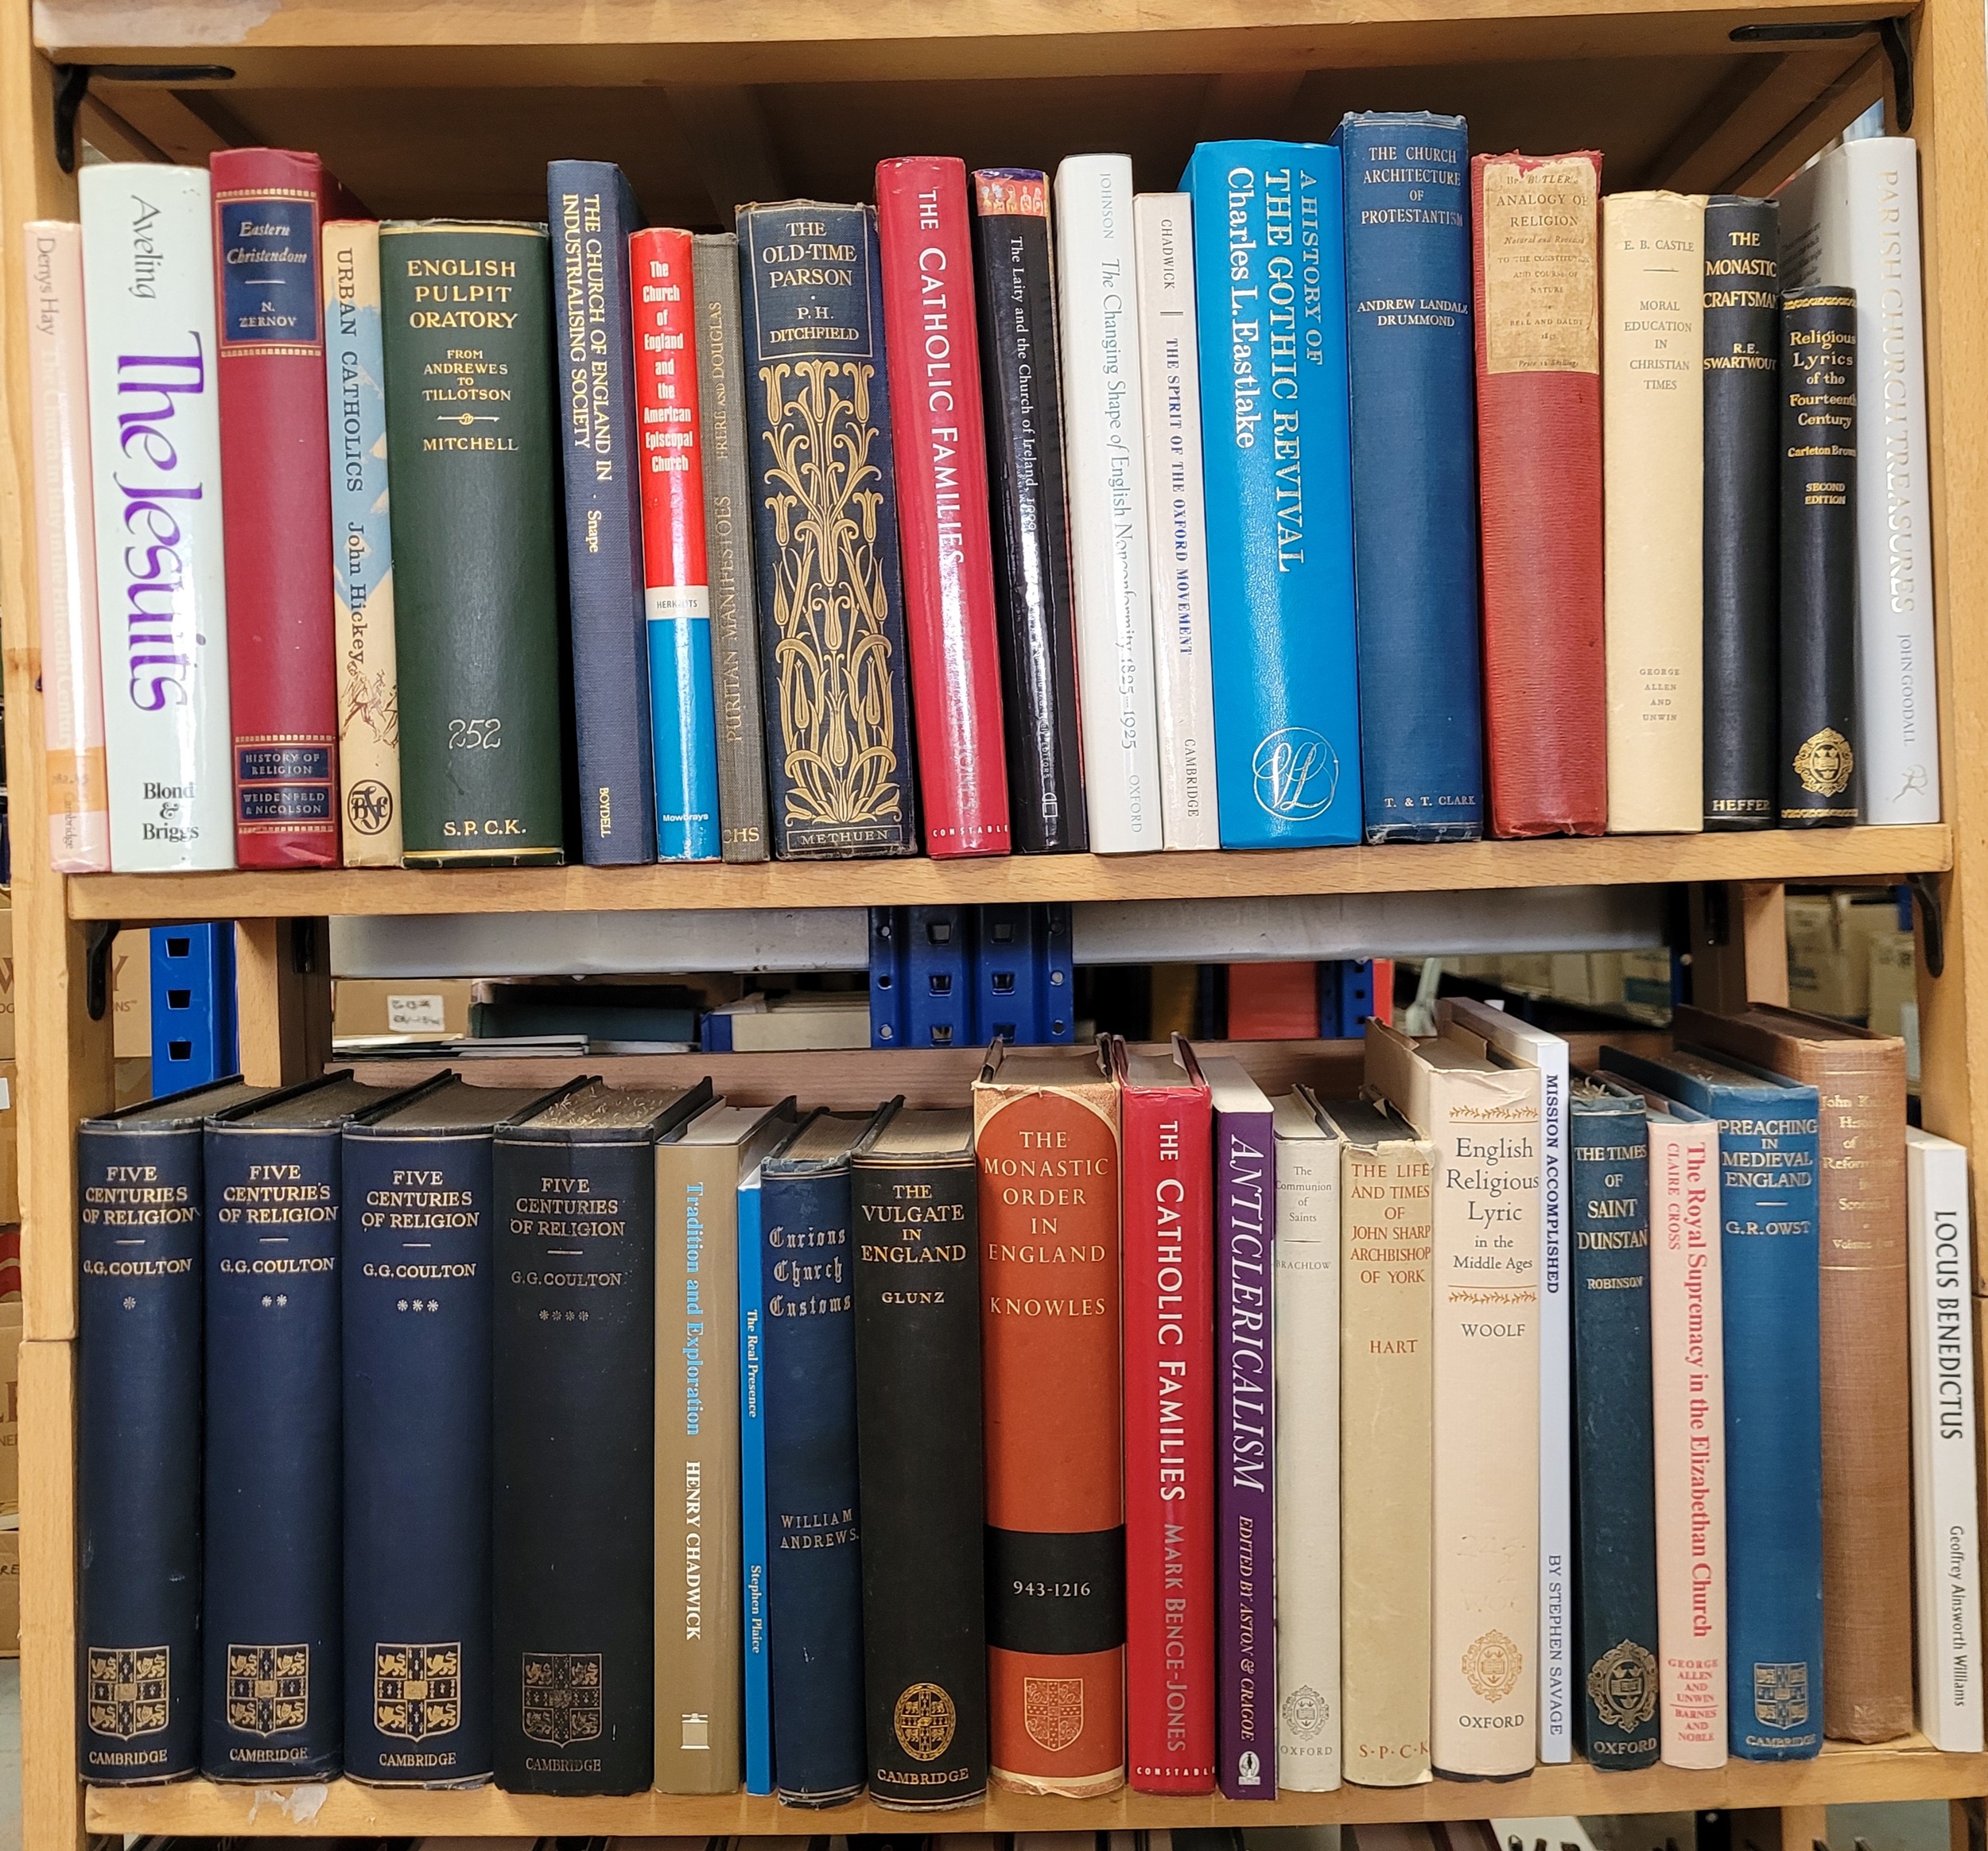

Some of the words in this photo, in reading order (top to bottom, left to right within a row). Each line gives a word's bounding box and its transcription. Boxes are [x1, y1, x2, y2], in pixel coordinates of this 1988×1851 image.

[1363, 170, 1461, 187] ARCHITECTURE
[584, 194, 600, 232] THE
[1100, 173, 1112, 239] JOHNSON
[1264, 168, 1293, 246] THE
[239, 223, 290, 237] Eastern
[1228, 167, 1256, 282] Charles
[1511, 215, 1578, 227] RELIGION
[1877, 170, 1900, 280] PARISH
[128, 195, 163, 299] Aveling
[227, 248, 308, 264] Christendom
[763, 245, 857, 264] OLD-TIME
[1011, 236, 1023, 263] The
[1160, 219, 1175, 289] CHADWICK
[37, 237, 55, 294] Denys
[407, 260, 515, 277] ENGLISH
[563, 194, 586, 363] INDUSTRIALISING
[770, 269, 852, 288] PARSON
[1706, 259, 1776, 278] MONASTIC
[337, 247, 356, 336] URBAN
[415, 286, 512, 303] PULPIT
[586, 239, 605, 323] CHURCH
[643, 286, 680, 302] Church
[1011, 268, 1024, 303] Laity
[1230, 286, 1257, 316] L.
[1640, 301, 1679, 312] MORAL
[37, 298, 59, 336] Hay
[239, 316, 297, 327] ZERNOV
[410, 312, 518, 328] ORATORY
[1015, 307, 1028, 332] and
[1268, 256, 1299, 401] GOTHIC
[1377, 315, 1454, 327] DRUMMOND
[1624, 321, 1691, 332] EDUCATION
[591, 330, 607, 355] OF
[644, 333, 683, 351] England
[709, 301, 725, 380] DOUGLAS
[770, 328, 859, 343] DITCHFIELD
[1017, 335, 1028, 359] the
[1165, 339, 1178, 369] THE
[1630, 360, 1690, 371] CHRISTIAN
[1793, 353, 1853, 369] Lyrics
[1881, 289, 1905, 425] CHURCH
[423, 390, 511, 401] TILLOTSON
[717, 383, 726, 406] AND
[1018, 365, 1031, 417] Church
[1230, 320, 1260, 448] Eastlake
[1644, 379, 1676, 390] TIMES
[118, 331, 204, 471] The
[571, 368, 590, 448] SOCIETY
[592, 361, 612, 454] ENGLAND
[1167, 376, 1182, 429] SPIRIT
[341, 351, 363, 492] CATHOLICS
[644, 407, 691, 424] American
[1022, 421, 1035, 435] of
[1798, 413, 1852, 429] Century
[423, 438, 518, 451] MITCHELL
[646, 431, 693, 448] Episcopal
[1170, 436, 1182, 456] OF
[596, 461, 612, 481] IN
[1171, 461, 1184, 492] THE
[1272, 409, 1305, 572] REVIVAL
[1804, 495, 1846, 505] EDITION
[1805, 483, 1845, 492] SECOND
[586, 510, 602, 553] Snape
[1172, 499, 1188, 562] OXFORD
[1885, 430, 1914, 613] TREASURES
[348, 522, 364, 576] John
[113, 471, 206, 711] Jesuits
[348, 584, 368, 664] Hickey
[1176, 568, 1192, 655] MOVEMENT
[448, 719, 501, 749] 252
[1184, 739, 1199, 817] CAMBRIDGE
[599, 787, 611, 838] BOYDELL
[1129, 774, 1142, 833] OXFORD
[1713, 799, 1769, 813] HEFFER
[663, 813, 709, 823] Mowbrays
[142, 822, 199, 844] Briggs
[802, 829, 889, 844] METHUEN
[1547, 1075, 1558, 1148] MISSION
[1159, 1120, 1178, 1162] THE
[1718, 1119, 1817, 1135] PREACHING
[1456, 1138, 1533, 1166] English
[1687, 1143, 1706, 1183] The
[1722, 1151, 1813, 1167] MEDIEVAL
[107, 1166, 157, 1182] FIVE
[984, 1158, 1109, 1176] MONASTIC
[1668, 1143, 1679, 1195] CLAIRE
[85, 1187, 188, 1203] CENTURIES
[1003, 1188, 1086, 1205] ORDER
[1446, 1170, 1540, 1197] Religious
[516, 1199, 619, 1214] CENTURIES
[862, 1205, 965, 1223] VULGATE
[1289, 1213, 1317, 1222] Saints
[1468, 1201, 1522, 1229] Lyric
[1683, 1189, 1706, 1250] Royal
[686, 1182, 703, 1273] Tradition
[1352, 1226, 1388, 1240] JOHN
[1393, 1225, 1431, 1240] SHARP
[1547, 1154, 1559, 1294] ACCOMPLISHED
[1668, 1203, 1679, 1250] CROSS
[861, 1245, 966, 1263] ENGLAND
[1350, 1248, 1431, 1261] ARCHBISHOP
[1578, 1231, 1648, 1250] DUNSTAN
[1933, 1211, 1959, 1288] LOCUS
[1155, 1178, 1184, 1345] CATHOLIC
[1587, 1276, 1643, 1289] ROBINSON
[687, 1280, 703, 1314] and
[882, 1291, 945, 1304] GLUNZ
[990, 1298, 1106, 1317] KNOWLES
[1683, 1253, 1708, 1368] Supremacy
[747, 1310, 758, 1332] The
[1230, 1134, 1265, 1493] ANTICLERICALISM
[1462, 1324, 1525, 1337] WOOLF
[747, 1336, 759, 1362] Real
[1370, 1340, 1418, 1353] HART
[682, 1322, 704, 1435] Exploration
[1689, 1374, 1710, 1392] in
[1937, 1298, 1963, 1440] BENEDICTUS
[747, 1365, 759, 1418] Presence
[1689, 1398, 1709, 1430] the
[1158, 1361, 1186, 1501] FAMILIES
[686, 1461, 701, 1528] HENRY
[1690, 1434, 1710, 1557] Elizabethan
[781, 1508, 853, 1529] WILLIAM
[1164, 1523, 1185, 1589] MARK
[1238, 1515, 1253, 1577] EDITED
[1950, 1525, 1965, 1579] Geoffrey
[1549, 1555, 1561, 1576] BY
[686, 1533, 701, 1640] CHADWICK
[748, 1566, 762, 1615] Stephen
[1013, 1581, 1091, 1597] 943-1216
[1240, 1581, 1254, 1601] BY
[1691, 1563, 1711, 1637] Church
[1240, 1605, 1254, 1655] ASTON
[1549, 1583, 1562, 1661] STEPHEN
[1951, 1585, 1967, 1651] Ainsworth
[751, 1619, 763, 1654] Plaice
[1164, 1598, 1187, 1752] BENCE-JONES
[1241, 1659, 1254, 1674] &
[1951, 1655, 1968, 1707] Williams
[1240, 1678, 1254, 1741] CRAGOE
[1550, 1667, 1562, 1736] SAVAGE
[1459, 1715, 1524, 1729] OXFORD
[88, 1749, 167, 1765] CAMBRIDGE
[379, 1752, 456, 1766] CAMBRIDGE
[1280, 1746, 1332, 1756] OXFORD
[1594, 1738, 1656, 1753] OXFORD
[877, 1768, 969, 1785] CAMBRIDGE
